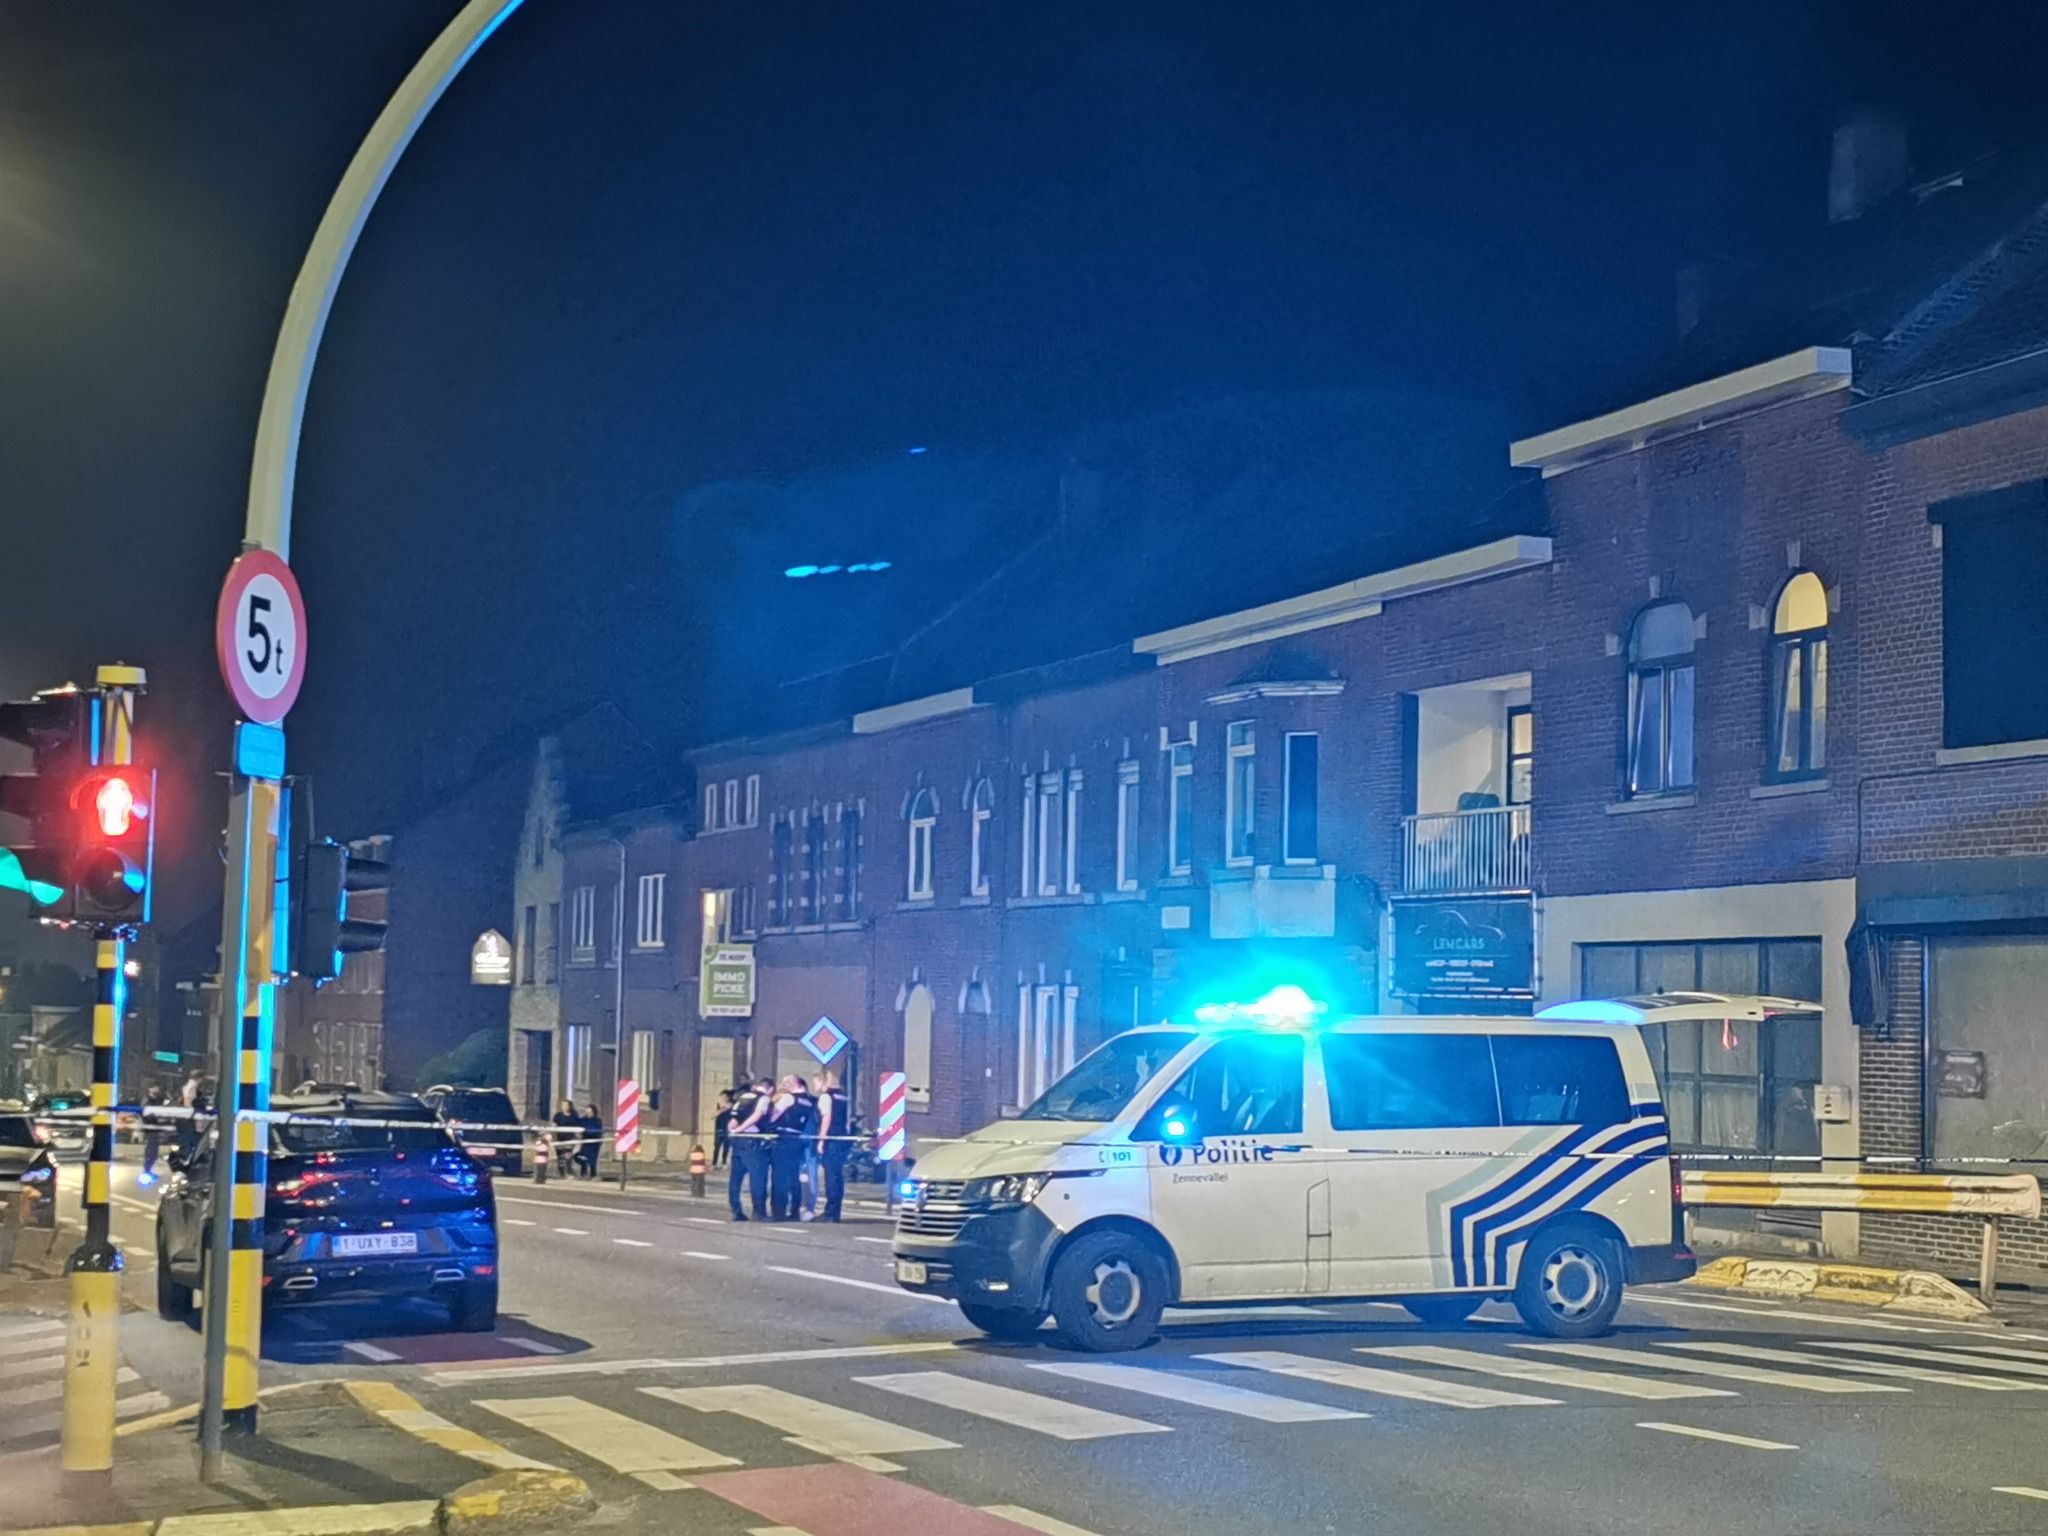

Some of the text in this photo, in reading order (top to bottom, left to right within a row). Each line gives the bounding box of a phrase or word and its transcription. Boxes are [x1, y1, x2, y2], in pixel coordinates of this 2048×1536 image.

[713, 971, 746, 982] IMMO
[1193, 1140, 1273, 1164] Politie
[1172, 1172, 1229, 1184] Zennevallei
